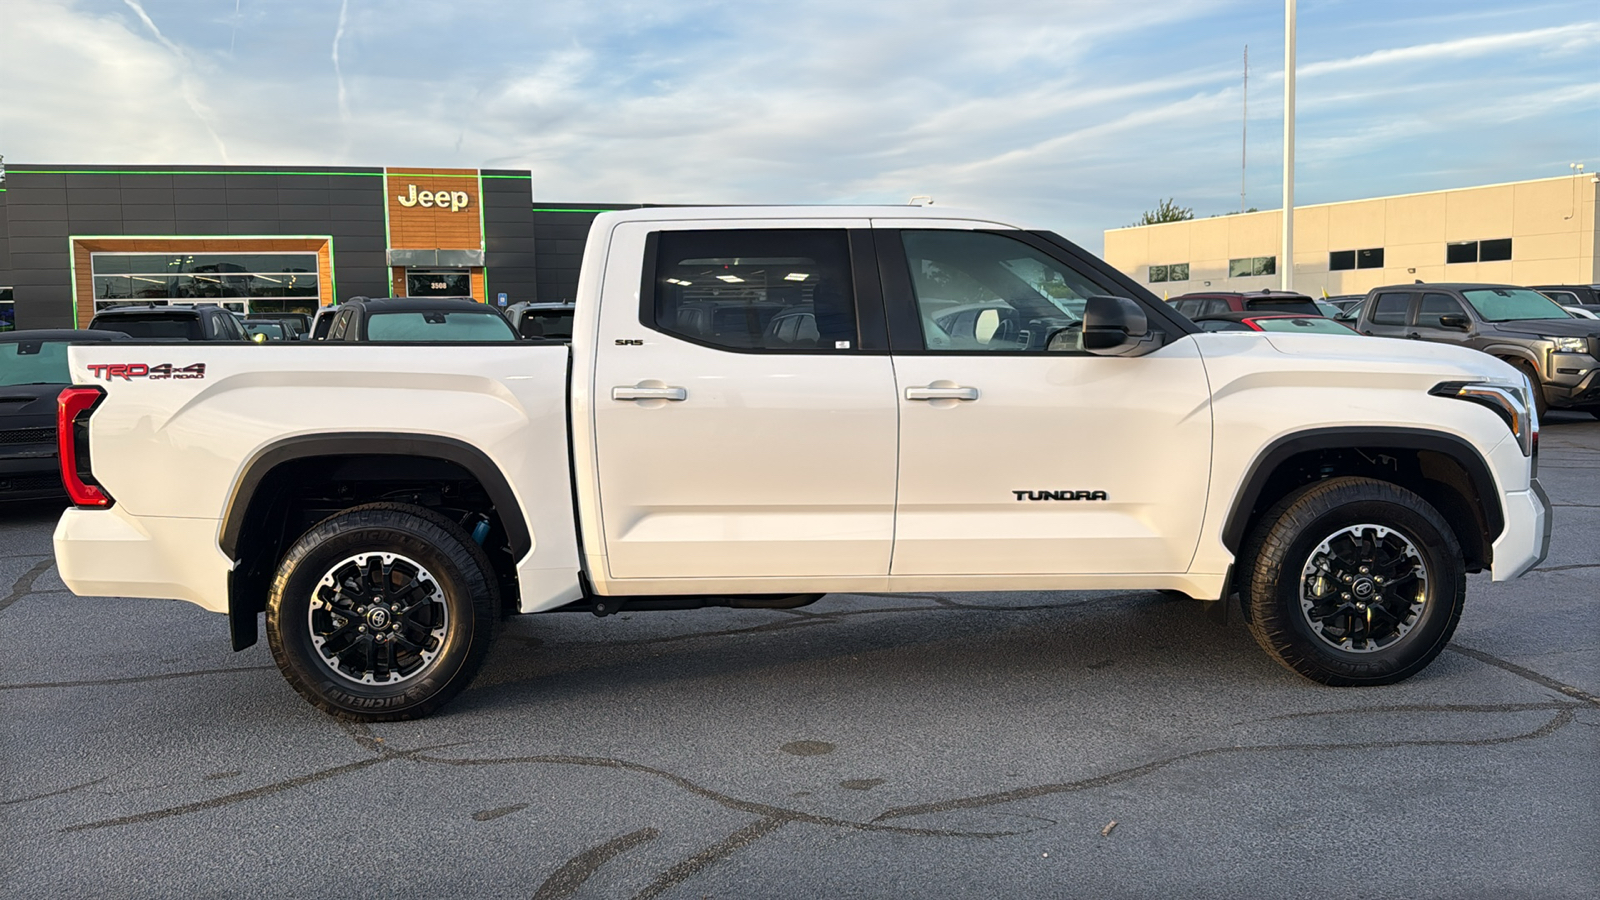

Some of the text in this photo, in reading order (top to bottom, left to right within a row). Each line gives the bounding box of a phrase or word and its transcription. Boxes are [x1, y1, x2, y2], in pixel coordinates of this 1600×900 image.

[398, 184, 469, 212] Jeep
[87, 363, 149, 381] TRD
[1012, 490, 1107, 501] TUNDRA
[327, 688, 405, 708] MICHELIN
